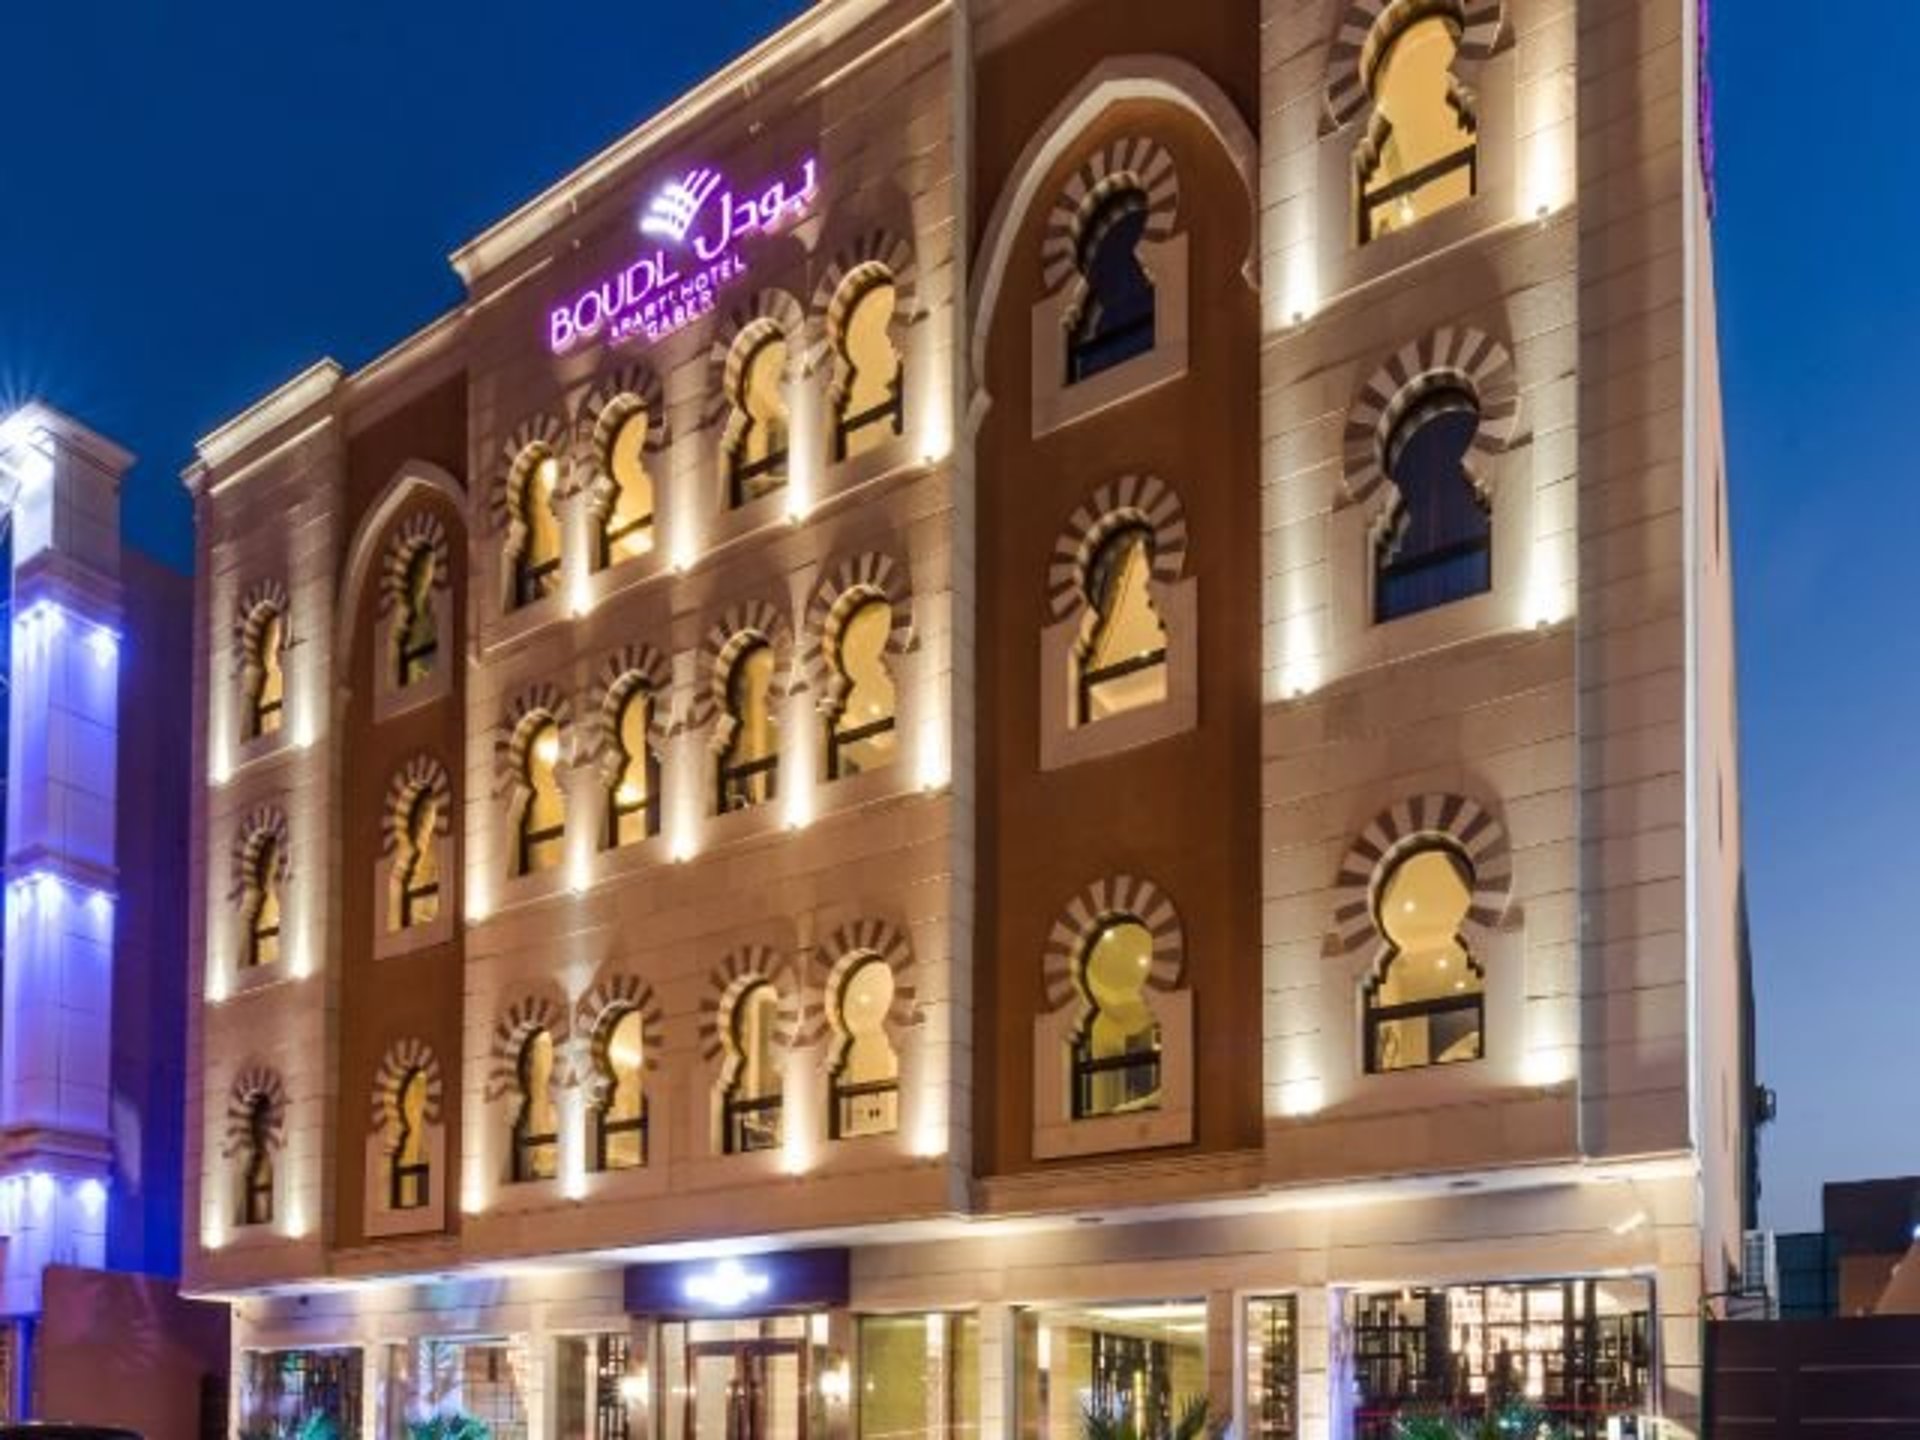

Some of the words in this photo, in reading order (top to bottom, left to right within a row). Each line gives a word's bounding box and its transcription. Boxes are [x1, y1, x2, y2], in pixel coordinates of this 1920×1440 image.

[693, 158, 818, 261] بودل
[549, 250, 680, 353] BOUDL
[680, 254, 747, 302] HOTEL
